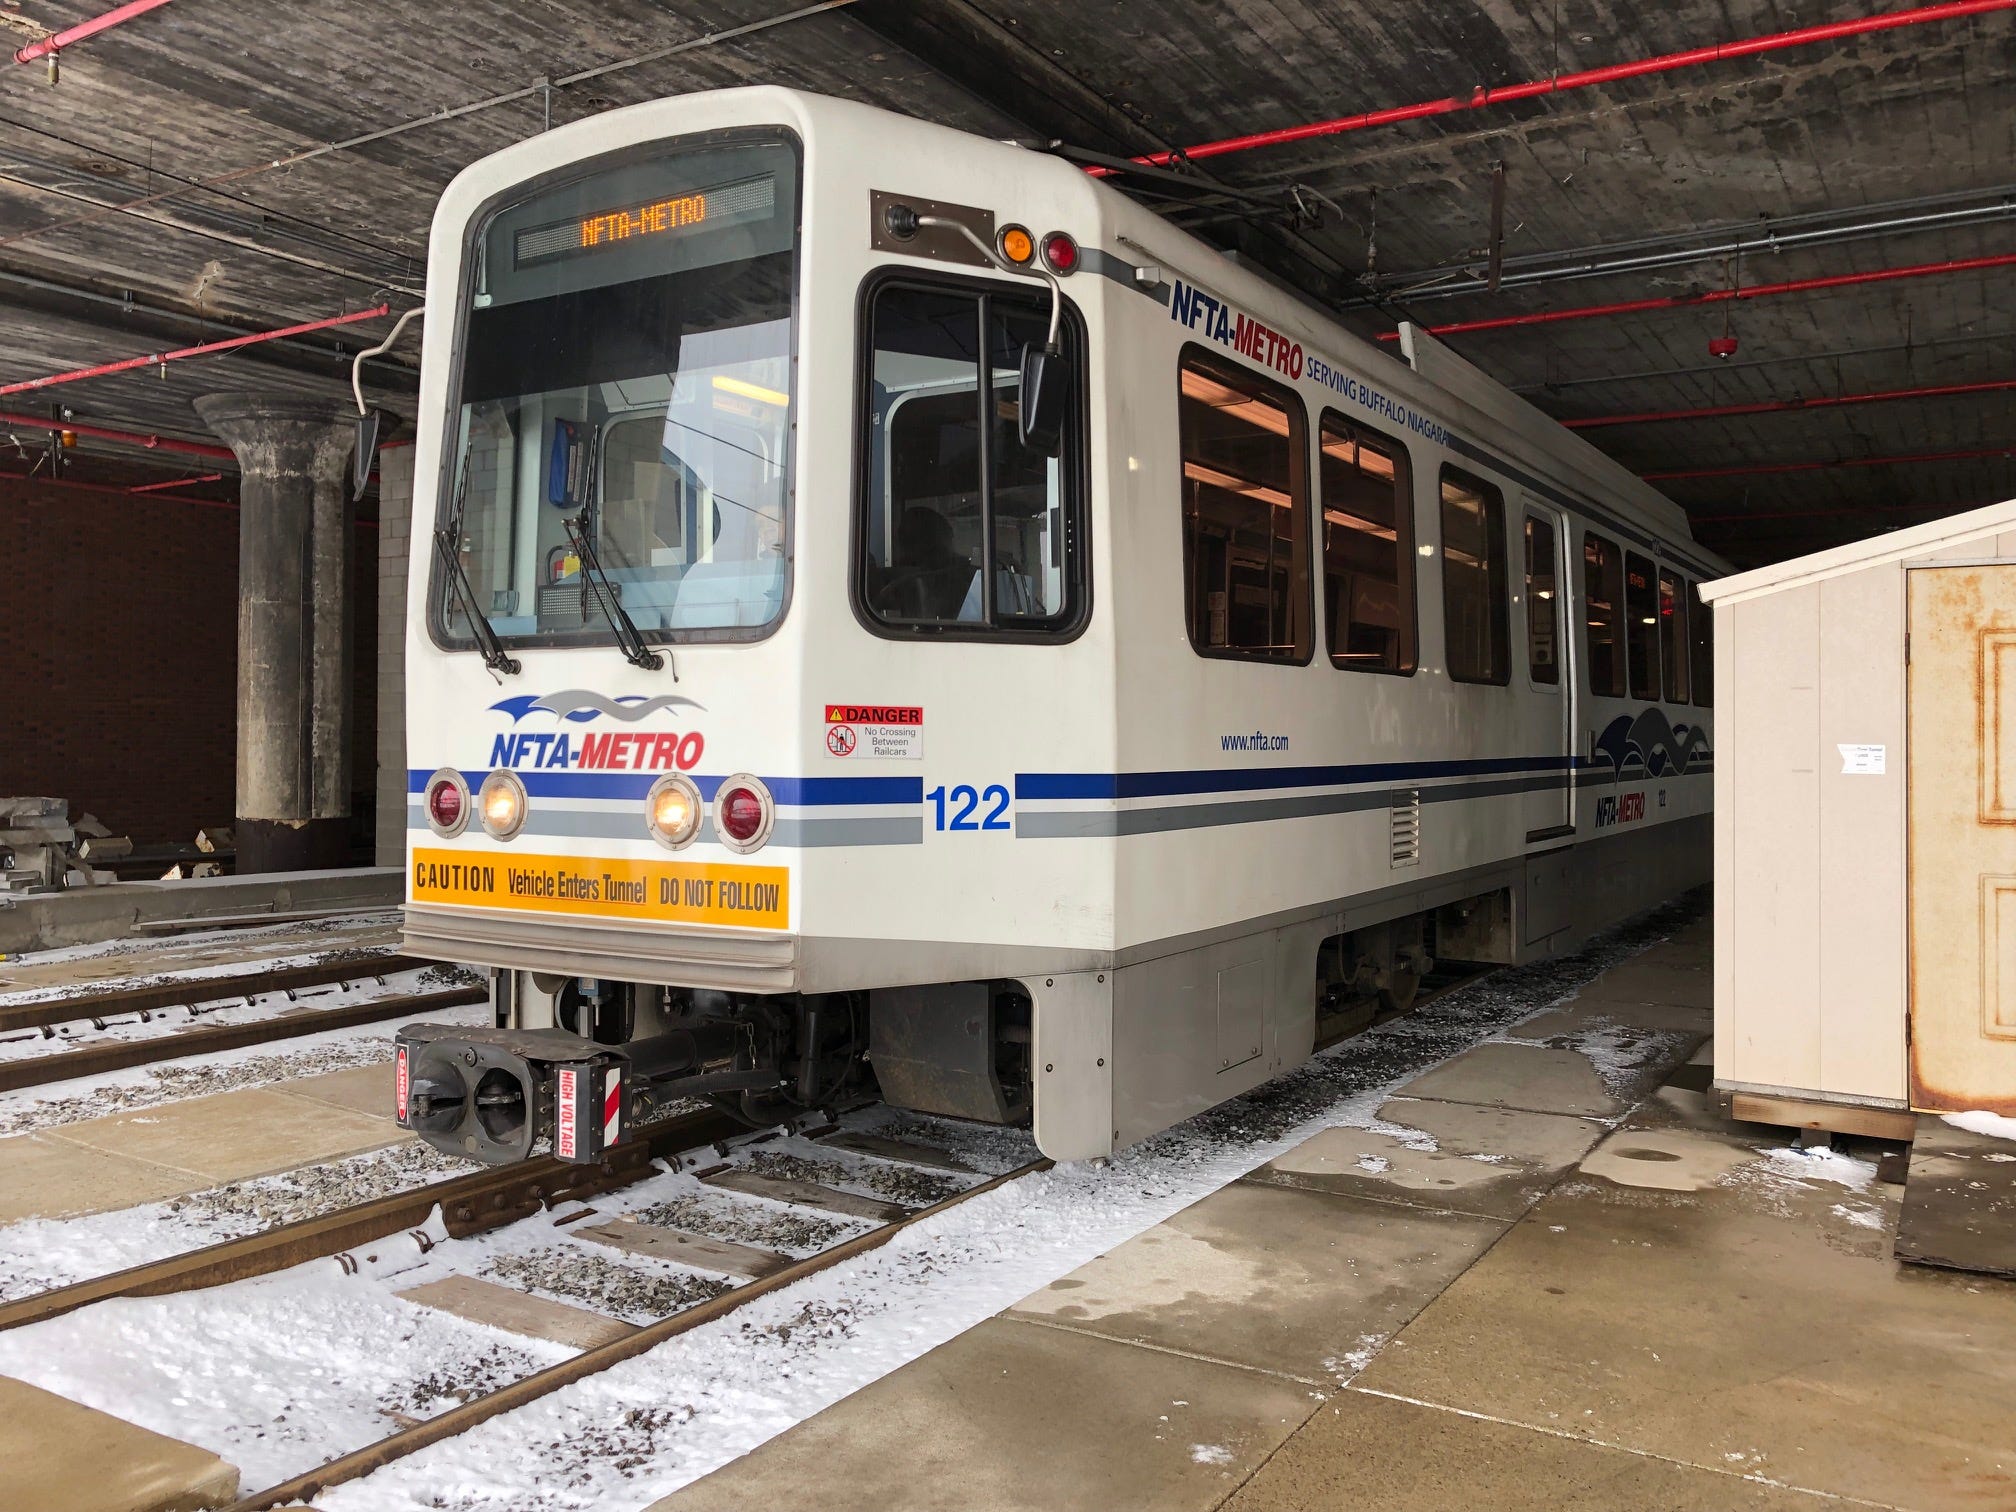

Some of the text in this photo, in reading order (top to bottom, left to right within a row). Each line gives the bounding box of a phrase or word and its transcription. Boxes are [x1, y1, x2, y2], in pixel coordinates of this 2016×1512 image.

[582, 195, 706, 247] NFTA-METRO
[1171, 279, 1450, 446] NFTA-METRO SERVING BUFFALO NIAGARA
[846, 708, 919, 723] DANGER
[864, 727, 916, 738] No Crossing
[489, 731, 705, 771] NFTA-METRO
[872, 737, 909, 746] Between
[874, 747, 907, 756] Railcars
[1221, 730, 1289, 751] www.nfta.com
[926, 785, 1011, 831] 122
[1595, 792, 1645, 828] NFTA-METRO
[416, 862, 780, 913] CAUTION Vehicle Enters Tunnel DO NOT FOLLOW
[561, 1071, 574, 1157] HIGH VOLTAGE
